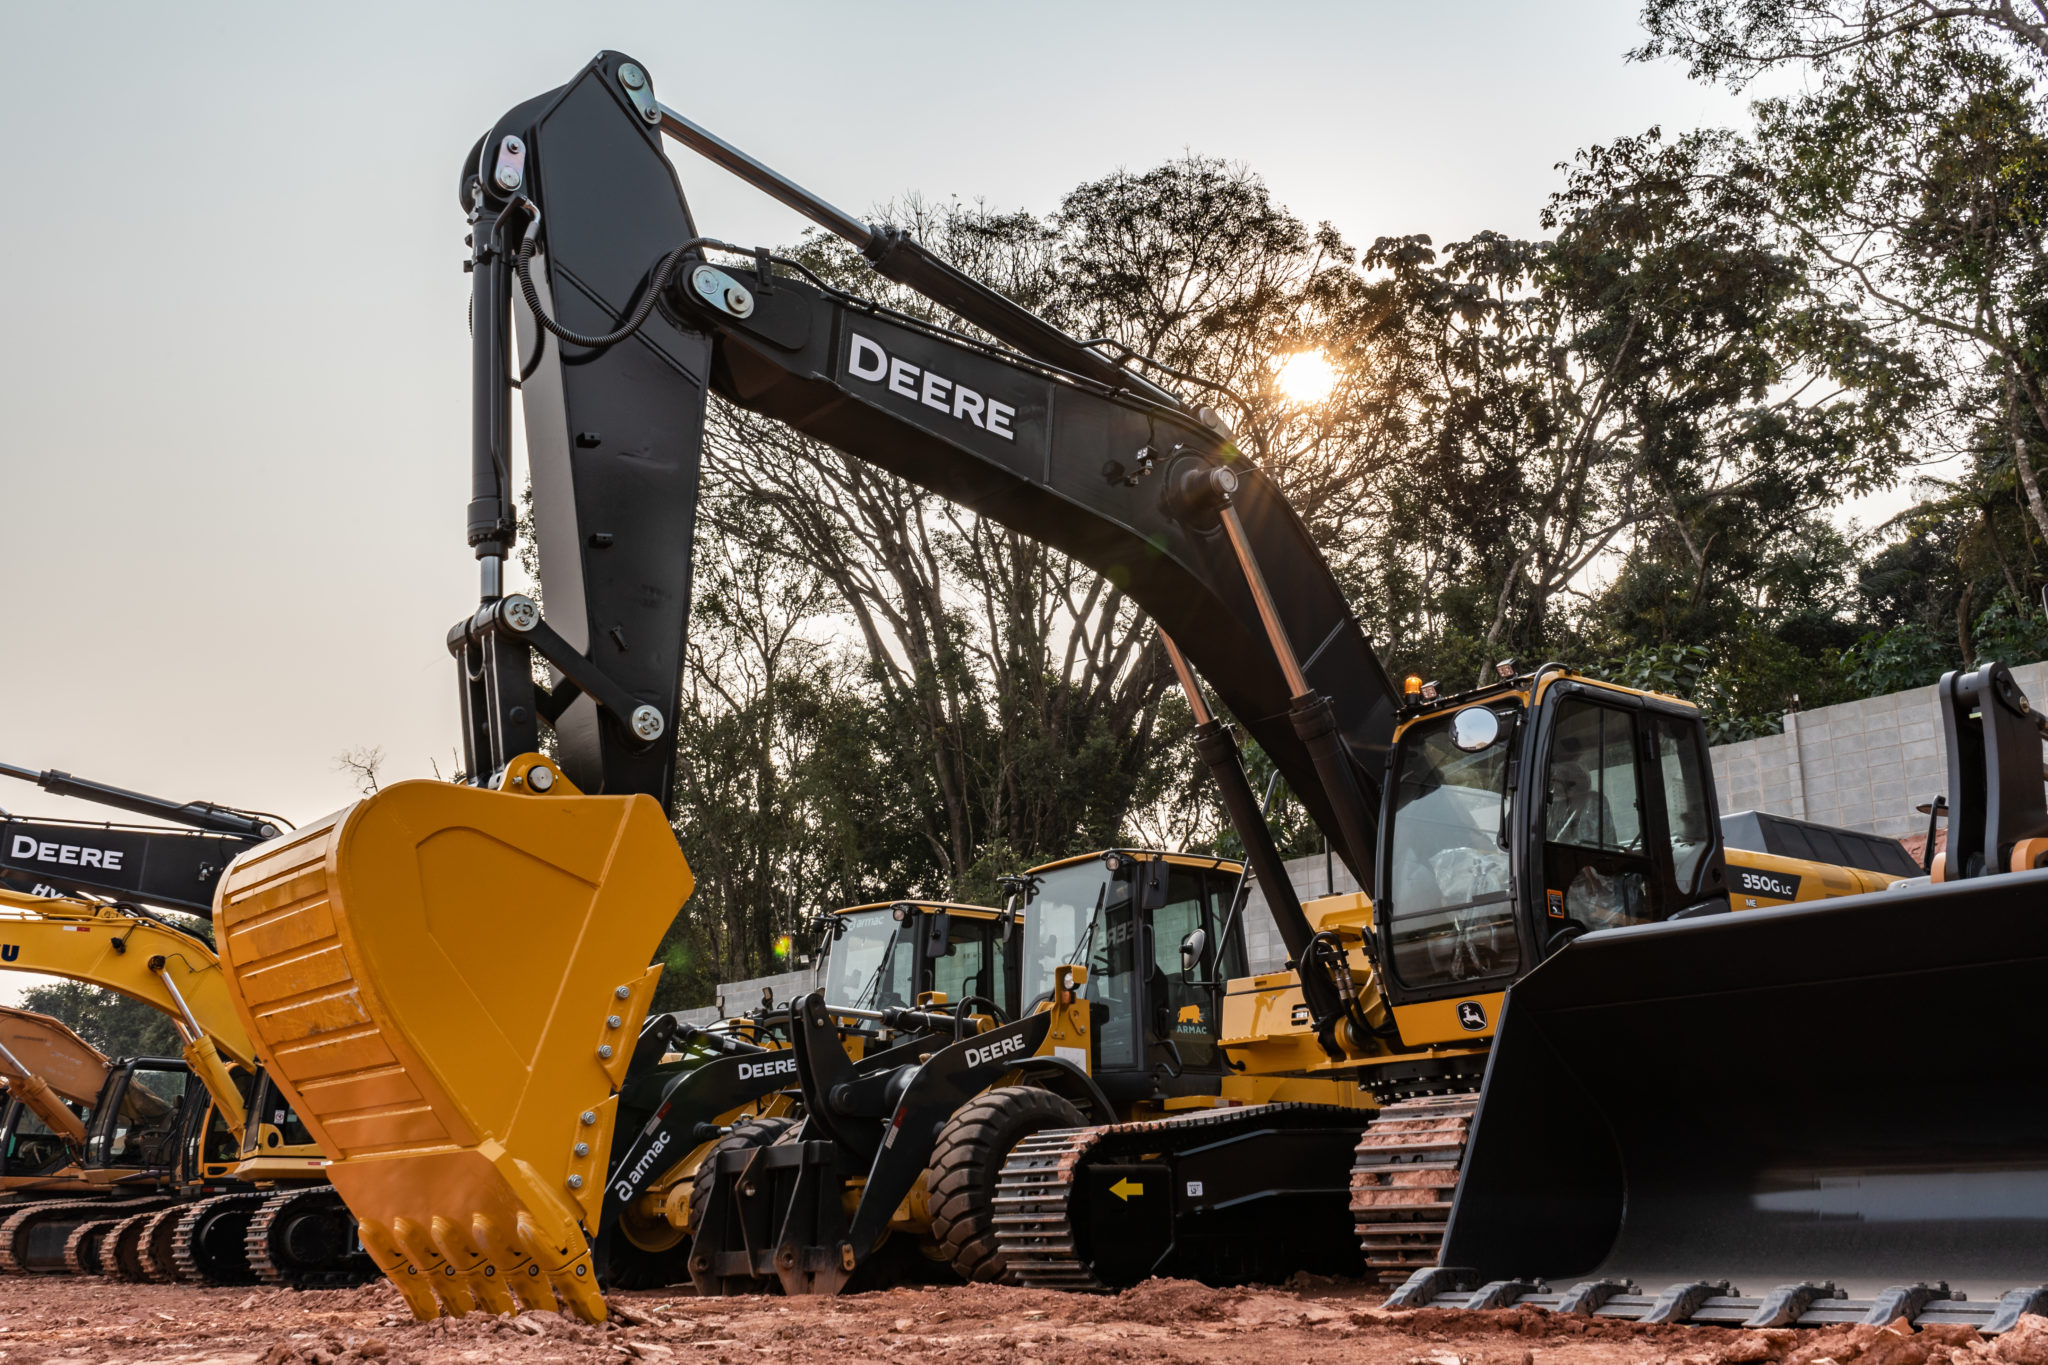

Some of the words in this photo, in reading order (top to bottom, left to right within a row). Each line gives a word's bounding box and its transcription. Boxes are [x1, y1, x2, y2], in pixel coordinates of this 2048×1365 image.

[849, 333, 1016, 440] DEERE
[11, 835, 124, 870] DEERE
[1176, 1025, 1207, 1035] ARMAC
[964, 1033, 1026, 1069] DEERE
[738, 1058, 797, 1080] DEERE
[628, 1130, 671, 1184] armac
